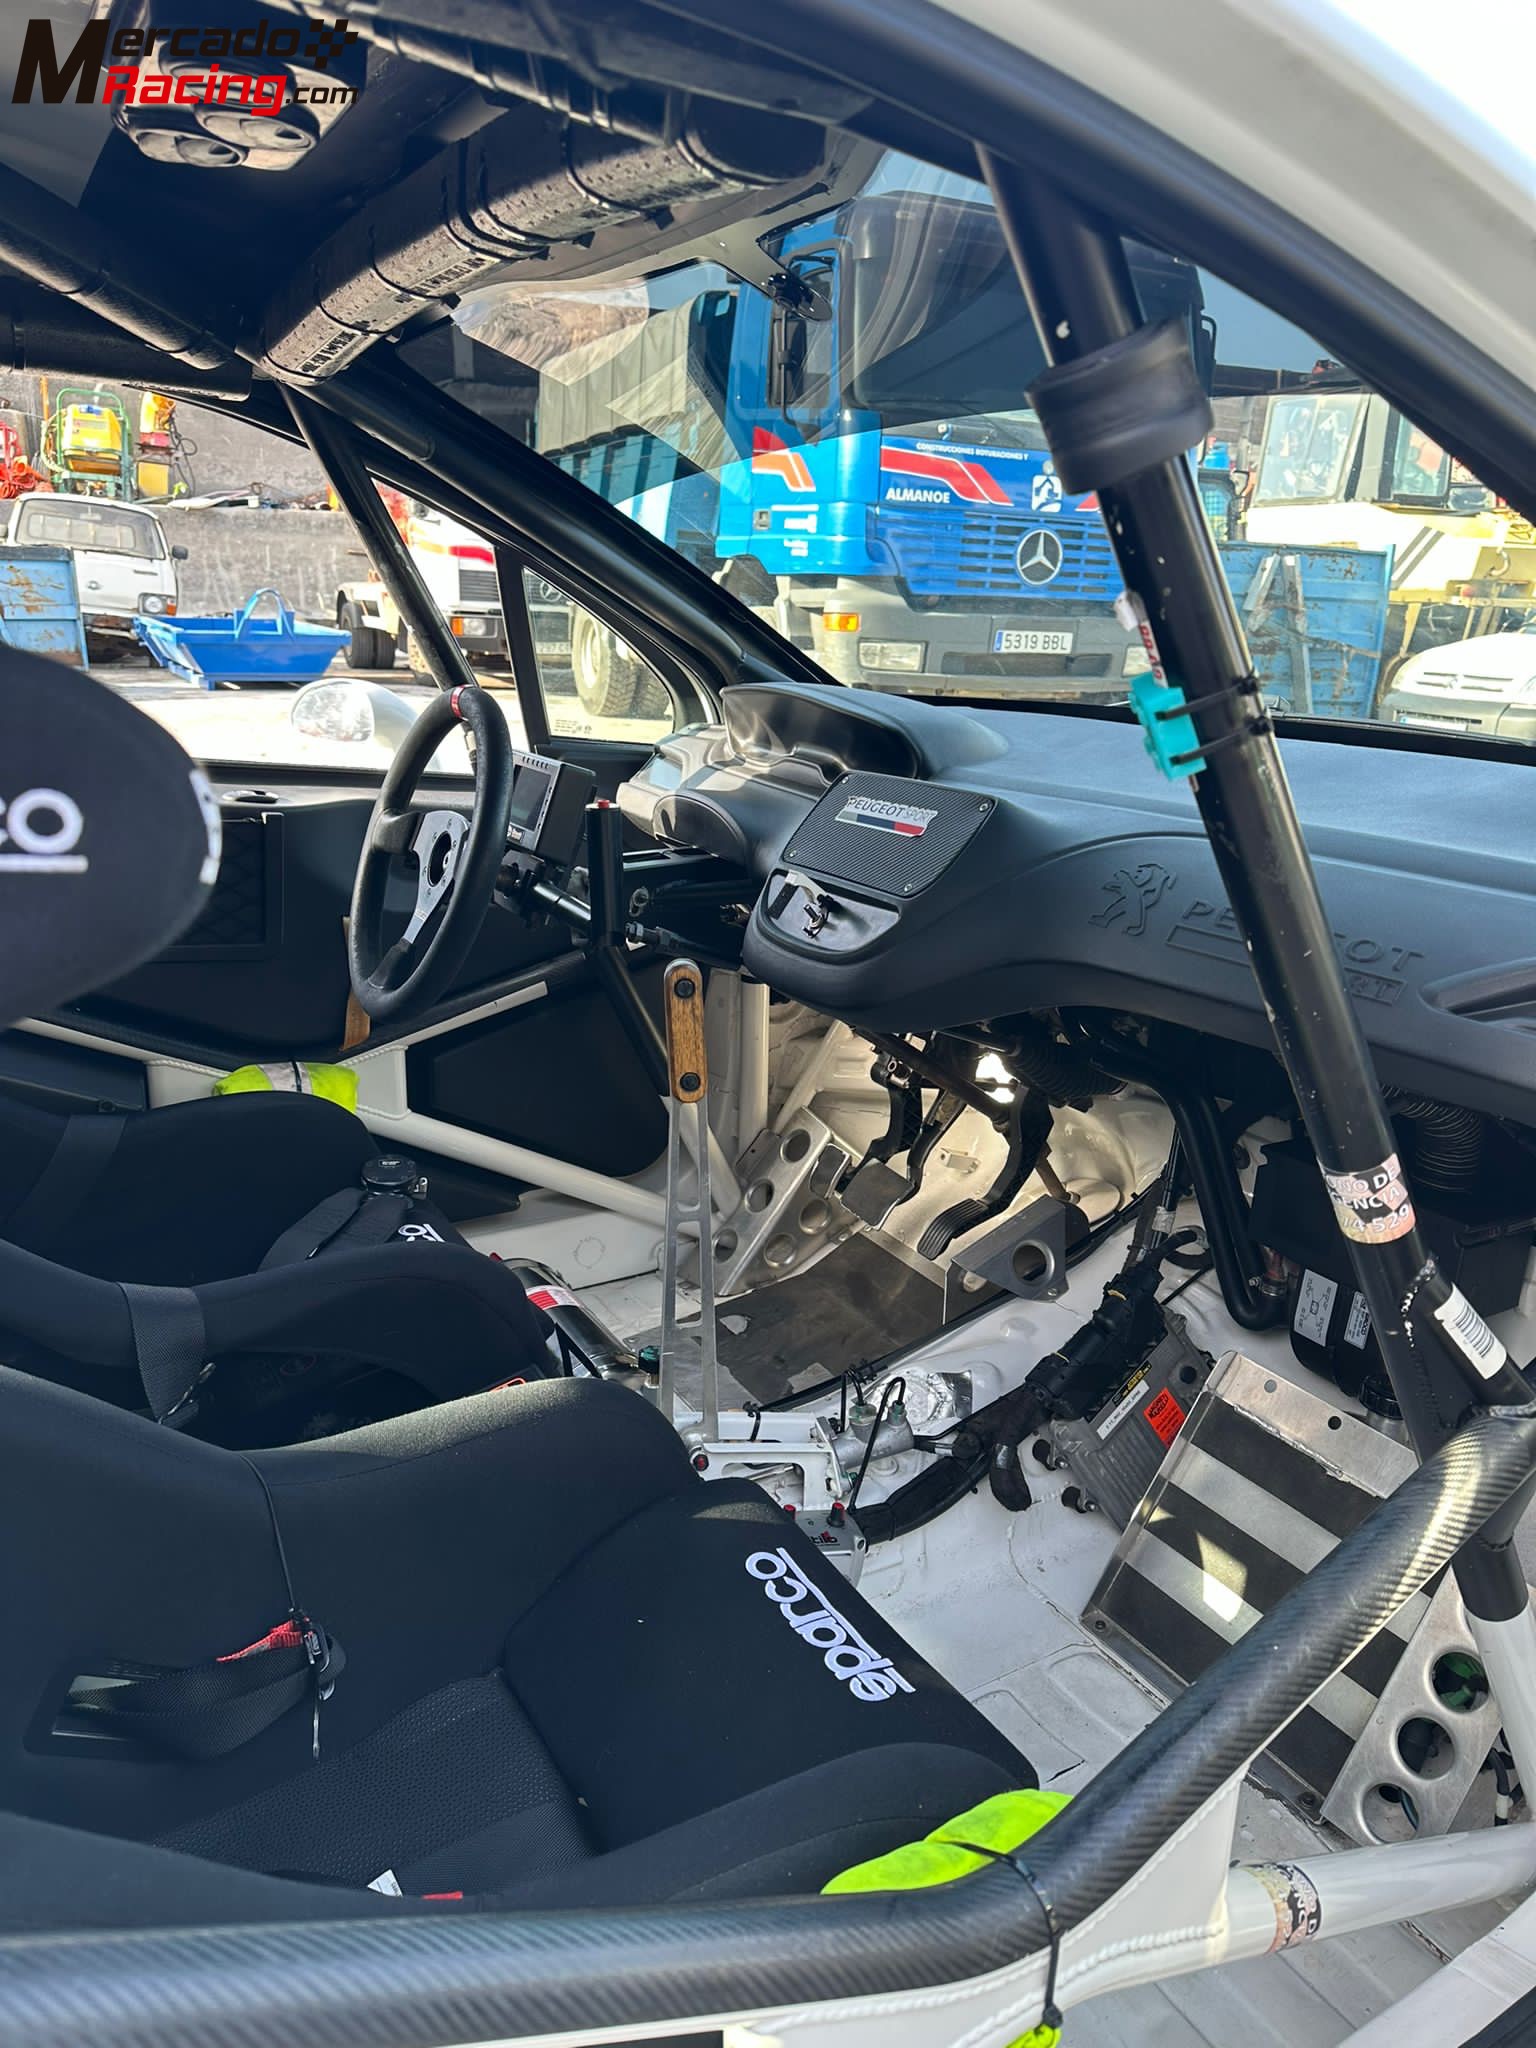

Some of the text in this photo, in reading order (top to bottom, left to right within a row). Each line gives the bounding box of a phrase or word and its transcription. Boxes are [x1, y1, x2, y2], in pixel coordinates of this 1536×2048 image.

[886, 488, 951, 504] ALMANOE
[1004, 634, 1067, 651] 5319 BBL
[847, 798, 905, 816] PEUGEOT
[1182, 901, 1424, 972] PEOT
[745, 1548, 905, 1702] sparco
